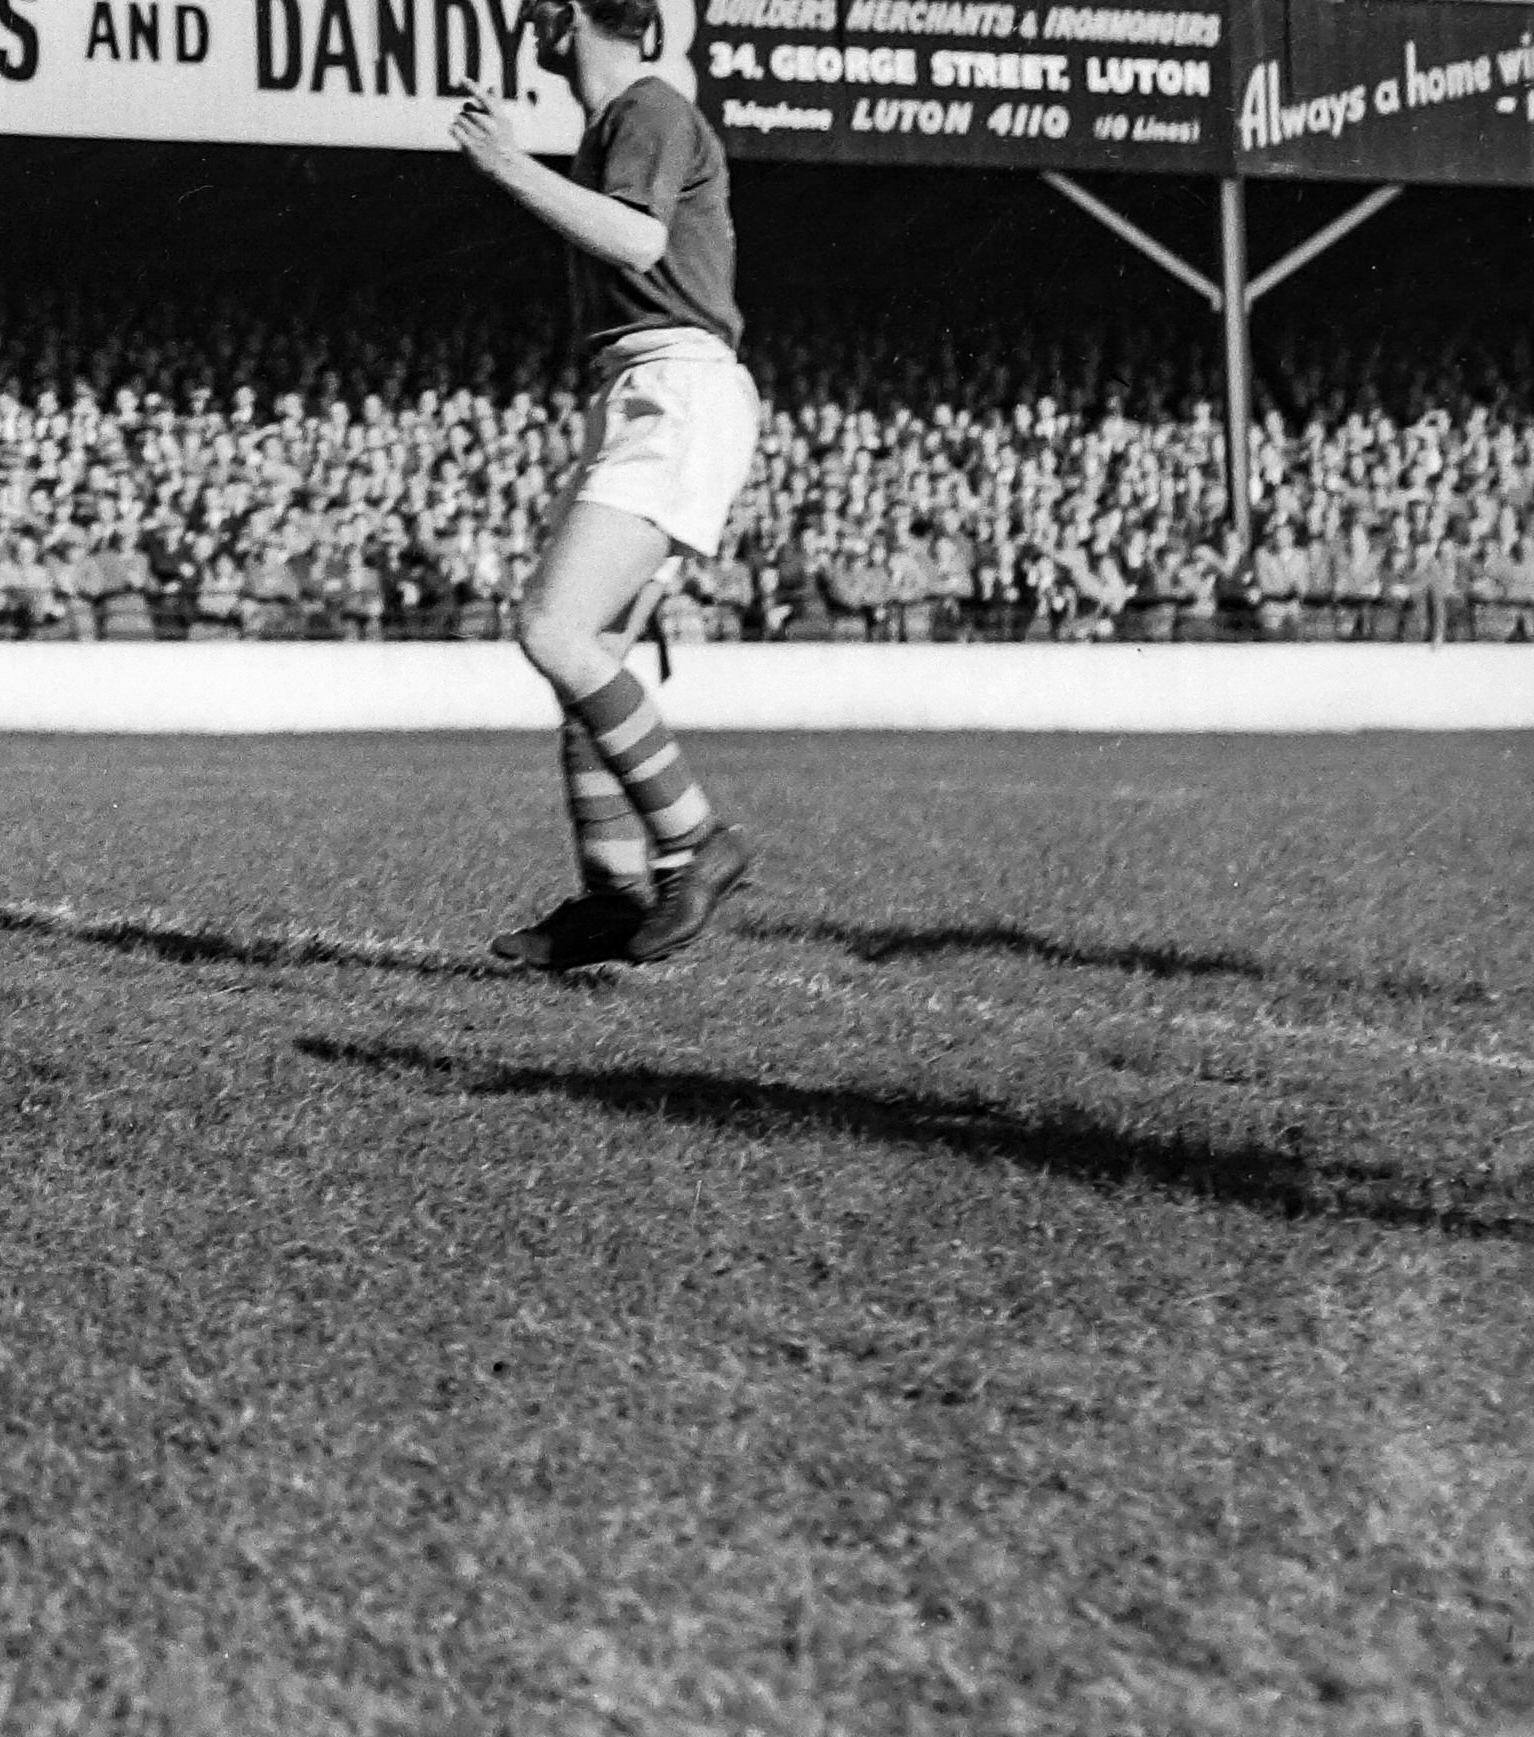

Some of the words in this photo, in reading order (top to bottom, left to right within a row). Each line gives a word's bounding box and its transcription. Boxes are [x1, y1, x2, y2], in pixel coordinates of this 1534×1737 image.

[86, 0, 211, 64] AND
[1042, 6, 1222, 48] IRONMONGERS
[769, 44, 918, 86] GEORGE
[1085, 55, 1212, 97] LUTON
[1239, 59, 1367, 153] Always
[1374, 77, 1402, 116] a
[1404, 38, 1493, 108] home
[850, 97, 974, 135] LUTON
[986, 101, 1071, 140] 4110
